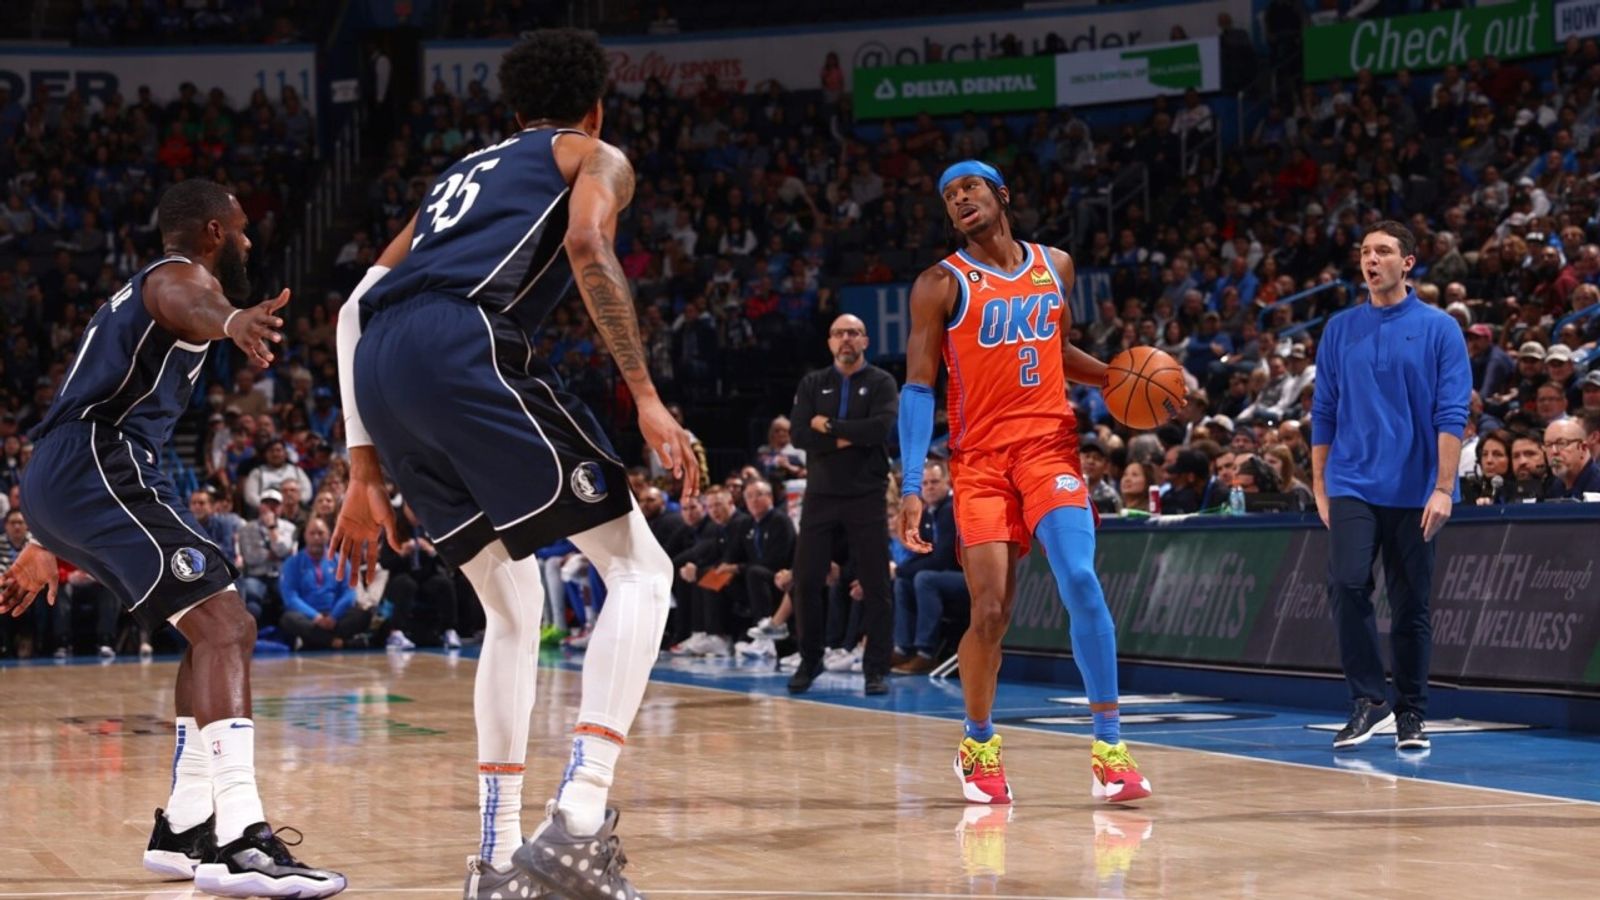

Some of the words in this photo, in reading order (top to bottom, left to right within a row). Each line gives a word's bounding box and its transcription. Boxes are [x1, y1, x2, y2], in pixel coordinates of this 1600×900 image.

[1350, 10, 1471, 73] Check
[1484, 2, 1539, 57] out
[679, 58, 743, 79] SPORTS
[901, 79, 957, 98] DELTA
[962, 73, 1038, 95] DENTAL
[426, 157, 501, 234] 35
[969, 270, 981, 283] 6
[978, 291, 1061, 349] OKC
[1018, 346, 1041, 388] 2
[1130, 551, 1256, 639] Benefits
[1438, 554, 1533, 600] HEALTH
[1530, 559, 1594, 600] through
[1431, 608, 1471, 646] ORAL
[1471, 609, 1579, 651] WELLNESS
